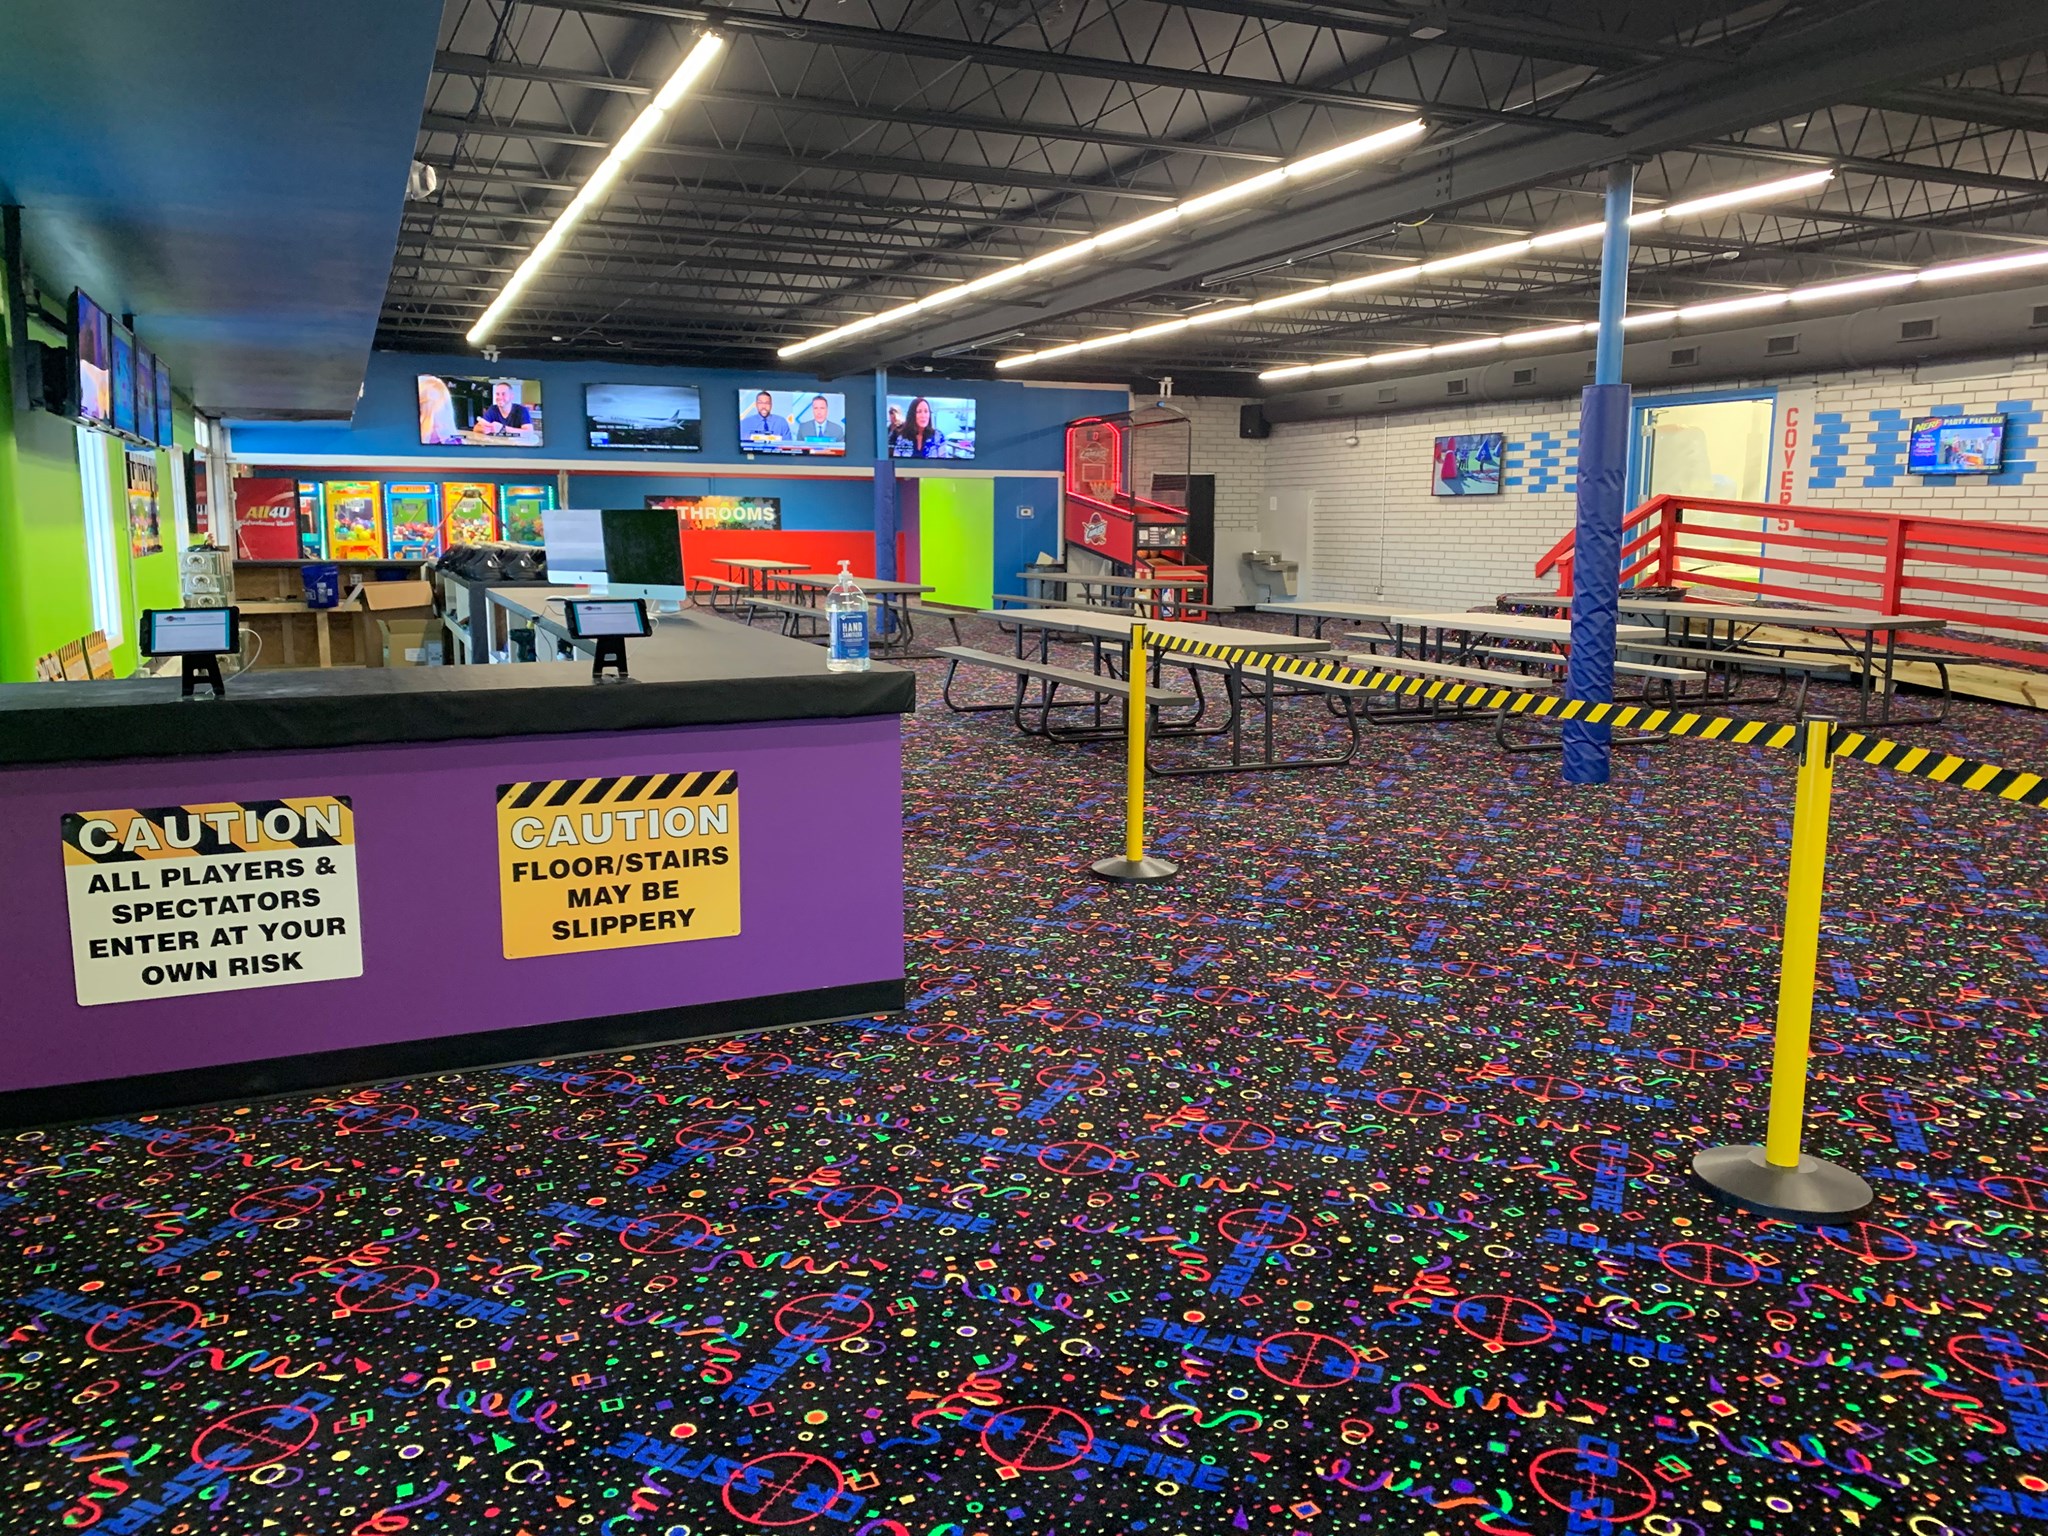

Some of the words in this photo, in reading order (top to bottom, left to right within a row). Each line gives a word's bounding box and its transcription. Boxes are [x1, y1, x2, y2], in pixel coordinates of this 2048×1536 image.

[1914, 418, 1943, 434] NERF
[842, 622, 863, 632] HAND
[78, 804, 342, 855] CAUTION
[511, 803, 728, 850] CAUTION
[87, 871, 150, 894] ALL
[161, 858, 304, 888] PLAYERS
[315, 855, 337, 875] &
[512, 845, 729, 883] FLOOR/STAIRS
[112, 887, 321, 924] SPECTATORS
[568, 884, 631, 909] MAY
[642, 880, 679, 902] BE
[89, 931, 199, 959] ENTER
[210, 926, 249, 948] AT
[258, 917, 346, 942] YOUR
[552, 907, 696, 941] SLIPPERY
[141, 960, 218, 985] OWN
[228, 951, 303, 977] RISK
